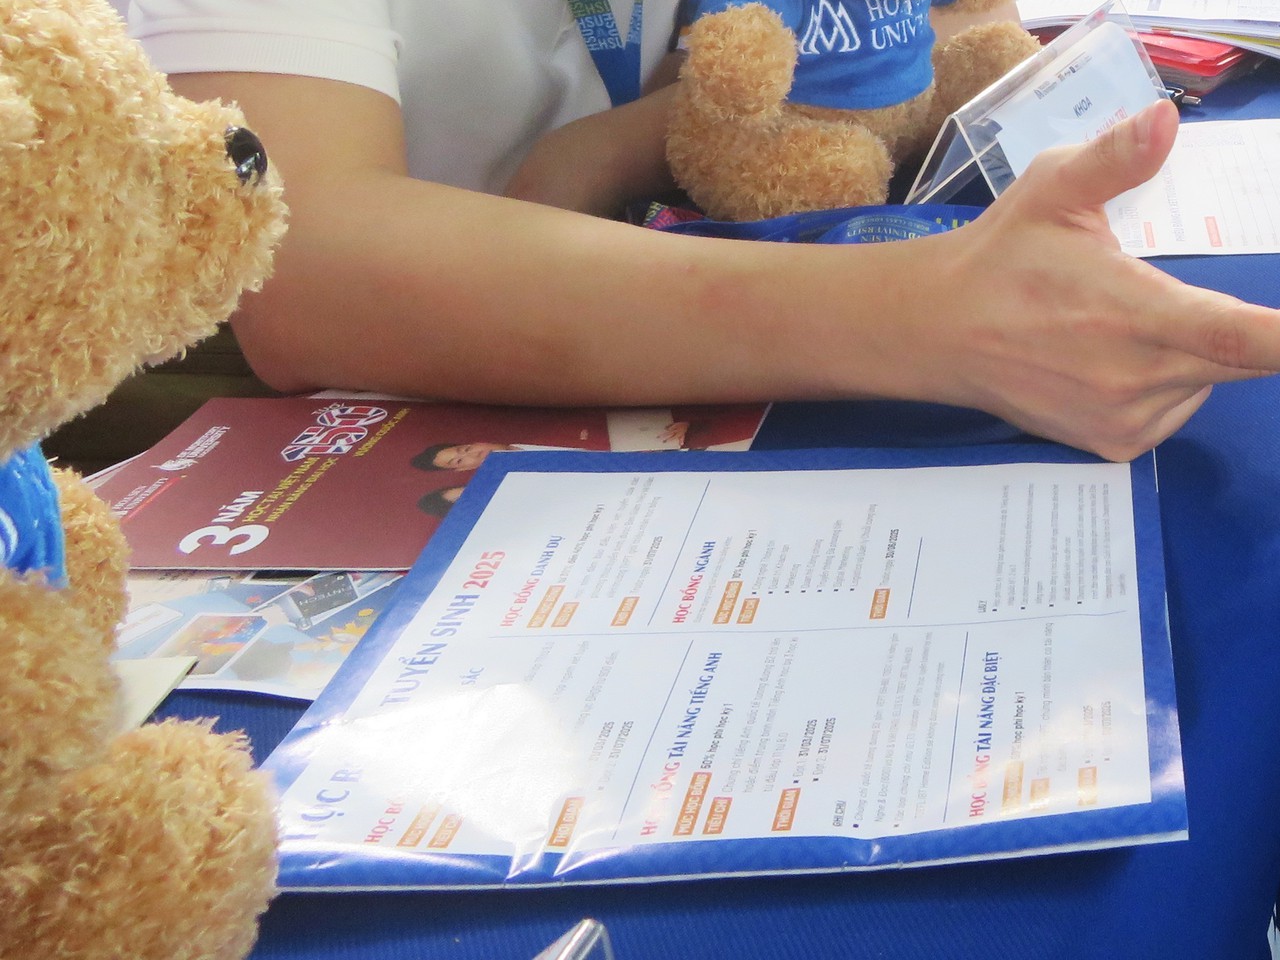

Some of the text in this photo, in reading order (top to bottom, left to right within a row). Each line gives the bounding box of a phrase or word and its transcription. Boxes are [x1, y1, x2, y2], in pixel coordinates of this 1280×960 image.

[1073, 95, 1093, 118] KHOA
[211, 491, 264, 523] NĂM
[242, 503, 271, 522] HỌC
[293, 457, 320, 476] NAM
[178, 524, 270, 555] 3
[500, 535, 566, 627] HỌC BỔNG DANH DỰ
[672, 540, 716, 624] HỌC BỔNG NGÀNH
[379, 551, 505, 707] TUYỂN SINH 2025
[667, 652, 722, 759] TÀI NĂNG TIẾNG ANH
[973, 651, 1002, 752] TÀI NĂNG ĐẶC BIỆT
[969, 792, 991, 818] HỌC
